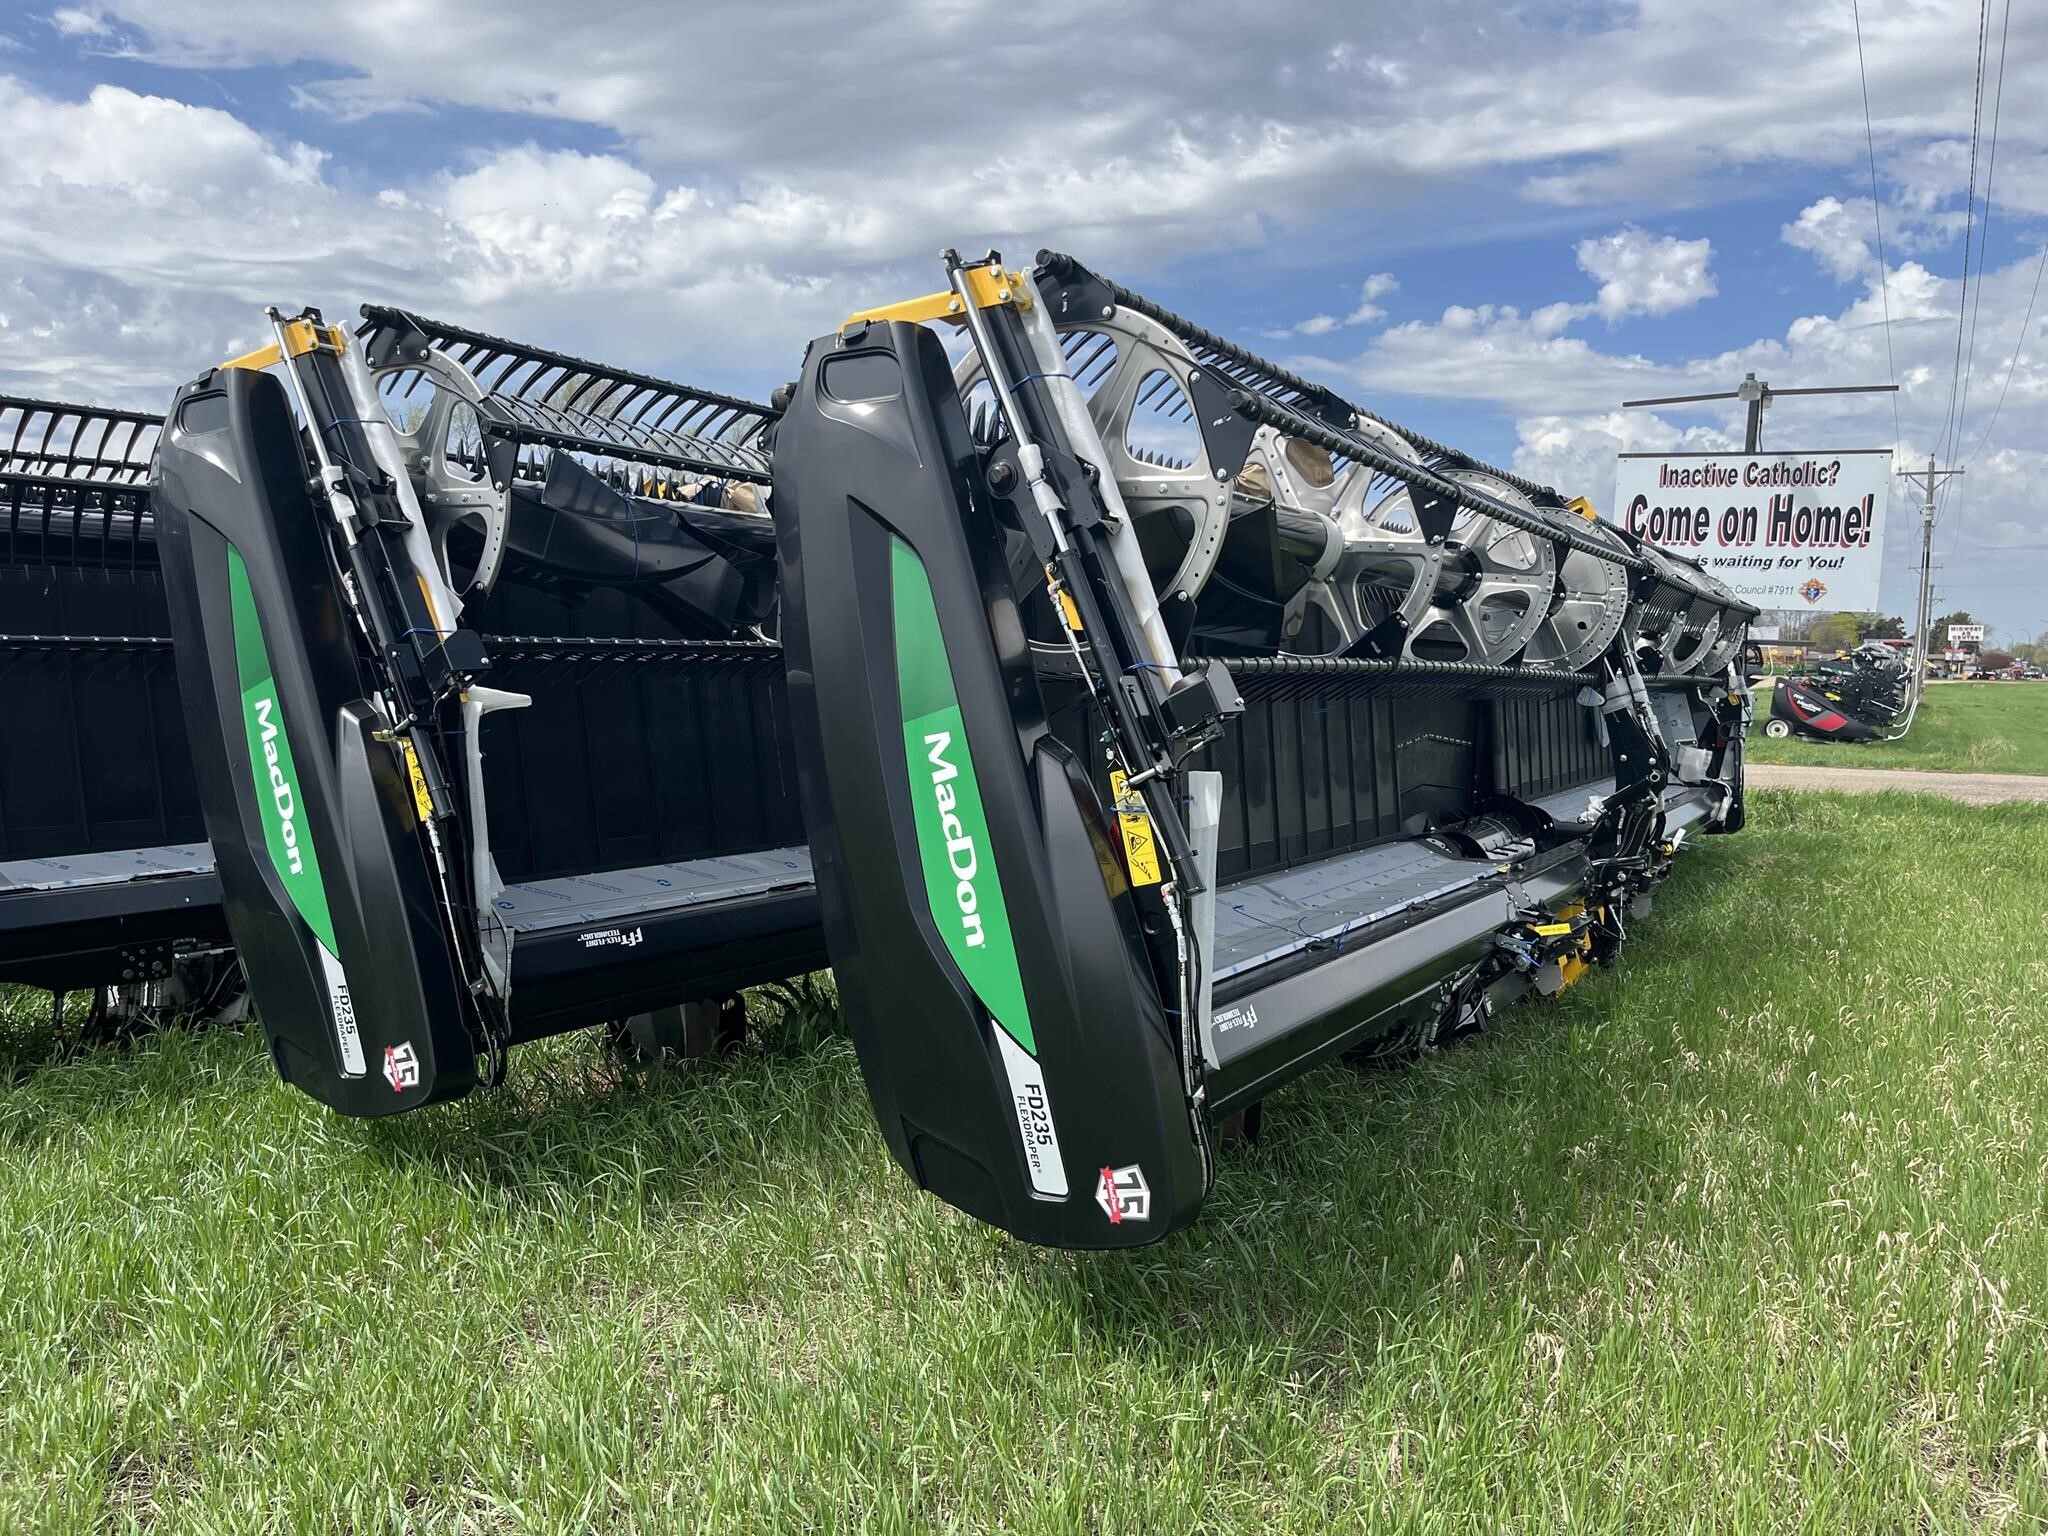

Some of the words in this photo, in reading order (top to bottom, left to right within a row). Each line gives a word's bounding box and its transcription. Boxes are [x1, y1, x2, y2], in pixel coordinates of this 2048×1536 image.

[1660, 462, 1738, 488] Inactive
[1743, 460, 1841, 488] Catholic?
[1625, 494, 1710, 547] Come
[1717, 505, 1758, 547] on
[1765, 493, 1875, 548] Home!
[1713, 554, 1773, 572] waiting
[1776, 555, 1802, 569] for
[1808, 556, 1845, 570] You!
[1734, 584, 1767, 595] Council
[1768, 585, 1794, 596] #7911
[255, 698, 303, 875] MacDon
[924, 731, 985, 948] MacDon
[338, 984, 356, 1035] FD235
[388, 1047, 415, 1083] 75
[1017, 1095, 1041, 1170] FLEXDRAPER
[1025, 1084, 1053, 1145] FD235
[1103, 1171, 1144, 1214] 75
